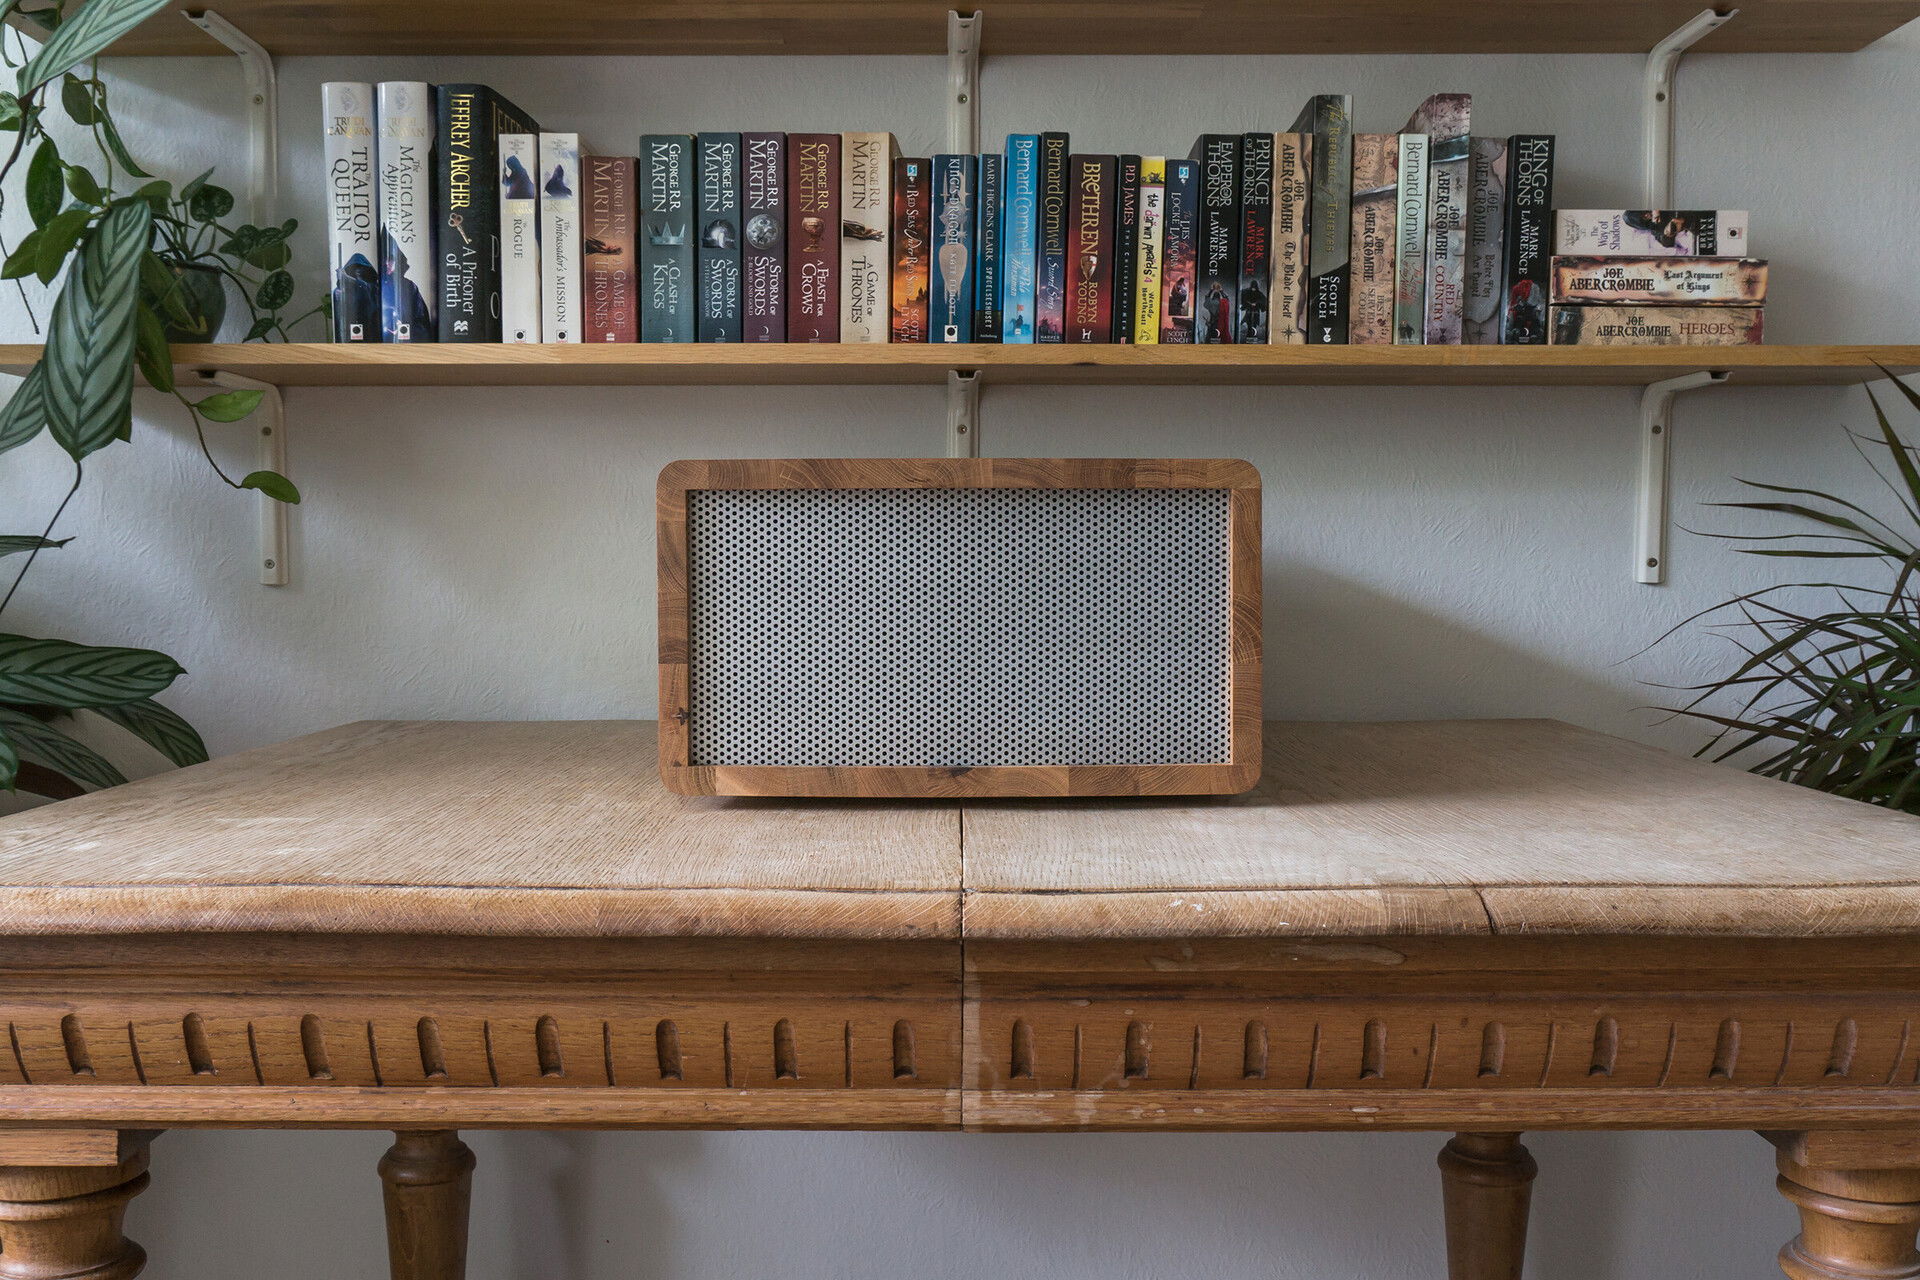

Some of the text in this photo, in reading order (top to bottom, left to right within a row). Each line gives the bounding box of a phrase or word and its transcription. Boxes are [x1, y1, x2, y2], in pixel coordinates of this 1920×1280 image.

[412, 159, 423, 173] The
[450, 92, 475, 210] JEFFREY ARCHER
[669, 143, 681, 188] GEORGE
[722, 143, 734, 188] GEORGE
[766, 140, 779, 186] GEORGE
[817, 144, 830, 188] GEORGE
[870, 141, 881, 186] GEORGE
[1255, 138, 1270, 206] PRINCE
[1406, 142, 1422, 196] Bernard
[1517, 139, 1532, 206] THORNS
[1532, 139, 1548, 205] KING OF
[331, 158, 352, 233] QUEEN
[351, 146, 371, 244] TRAITOR
[399, 145, 417, 244] MAGICIAN'S
[612, 160, 626, 209] GEORGE
[652, 142, 668, 213] MARTIN
[704, 142, 722, 212] MARTIN
[749, 140, 766, 210] MARTIN
[800, 142, 816, 212] MARTIN
[852, 140, 868, 210] MARTIN
[1206, 142, 1220, 207] THORNS
[1220, 142, 1232, 206] EMPEROR
[1243, 149, 1255, 205] THORNS
[1280, 144, 1294, 234] ABERCROMBIE
[1294, 180, 1304, 201] JOE
[382, 163, 400, 233] Apprentice
[593, 160, 612, 238] MARTIN
[906, 190, 918, 208] RED
[907, 210, 919, 228] SEAS
[985, 158, 995, 262] MARY HIGGINS CLARK
[1014, 140, 1033, 256] Bernard Cornwell
[1045, 139, 1064, 256] Bernard Cornwell
[1122, 186, 1135, 226] JAMES
[1148, 193, 1158, 208] the
[1436, 170, 1450, 260] ABERCROMBIE
[1449, 206, 1460, 228] JOE
[1472, 153, 1488, 247] ABERCROMBIE
[1488, 190, 1498, 212] JOE
[513, 219, 523, 259] ROGUE
[563, 221, 571, 231] The
[1144, 210, 1160, 240] darwin
[1170, 192, 1181, 268] LOCKE LAMORA
[1180, 220, 1190, 240] LIES
[1209, 211, 1219, 276] LAWRENCE
[1218, 227, 1228, 260] MARK
[1245, 210, 1256, 276] LAWRENCE
[1256, 226, 1265, 260] MARK
[1362, 206, 1374, 282] ABERCROMBIE
[1375, 236, 1384, 254] JOE
[1404, 199, 1421, 259] Cornwell
[1518, 210, 1530, 275] LAWRENCE
[1528, 226, 1539, 260] MARK
[1598, 220, 1609, 248] Way of
[1610, 214, 1621, 250] Shadows
[463, 246, 476, 257] A
[555, 216, 568, 323] Ambassador's MISSION
[906, 257, 918, 274] RED
[1282, 242, 1296, 261] The
[1602, 268, 1624, 278] JOE
[446, 253, 463, 308] of Birth
[462, 262, 477, 315] Prisoner
[594, 259, 610, 329] THRONES
[614, 270, 626, 308] GAME
[653, 263, 668, 309] KINGS
[668, 266, 680, 304] CLASH
[710, 258, 726, 319] SWORDS
[726, 268, 738, 308] STORM
[754, 256, 769, 316] SWORDS
[770, 265, 782, 306] STORM
[802, 263, 816, 314] CROWS
[817, 268, 829, 302] FEAST
[852, 256, 866, 323] THRONES
[866, 271, 879, 306] GAME
[1043, 258, 1060, 310] Sword Song
[1281, 262, 1296, 290] Blade
[1330, 276, 1340, 316] SCOTT
[1434, 265, 1445, 322] COUNTRY
[1446, 284, 1456, 305] RED
[1570, 278, 1654, 292] ABERCROMBIE
[1663, 270, 1723, 280] Last Argument
[1676, 282, 1711, 294] of Kings
[670, 305, 675, 314] OF
[727, 310, 733, 318] OF
[770, 306, 776, 316] OF
[866, 307, 872, 316] OF
[1077, 280, 1088, 324] YOUNG
[1088, 282, 1098, 324] ROBYN
[1319, 276, 1330, 319] LYNCH
[1359, 292, 1367, 320] COLD
[614, 312, 625, 328] OF
[900, 306, 910, 342] LYNCH
[910, 308, 919, 340] SCOTT
[1596, 326, 1672, 338] ABERCROMBIE
[1626, 316, 1644, 326] JOE
[1679, 322, 1736, 336] HEROES
